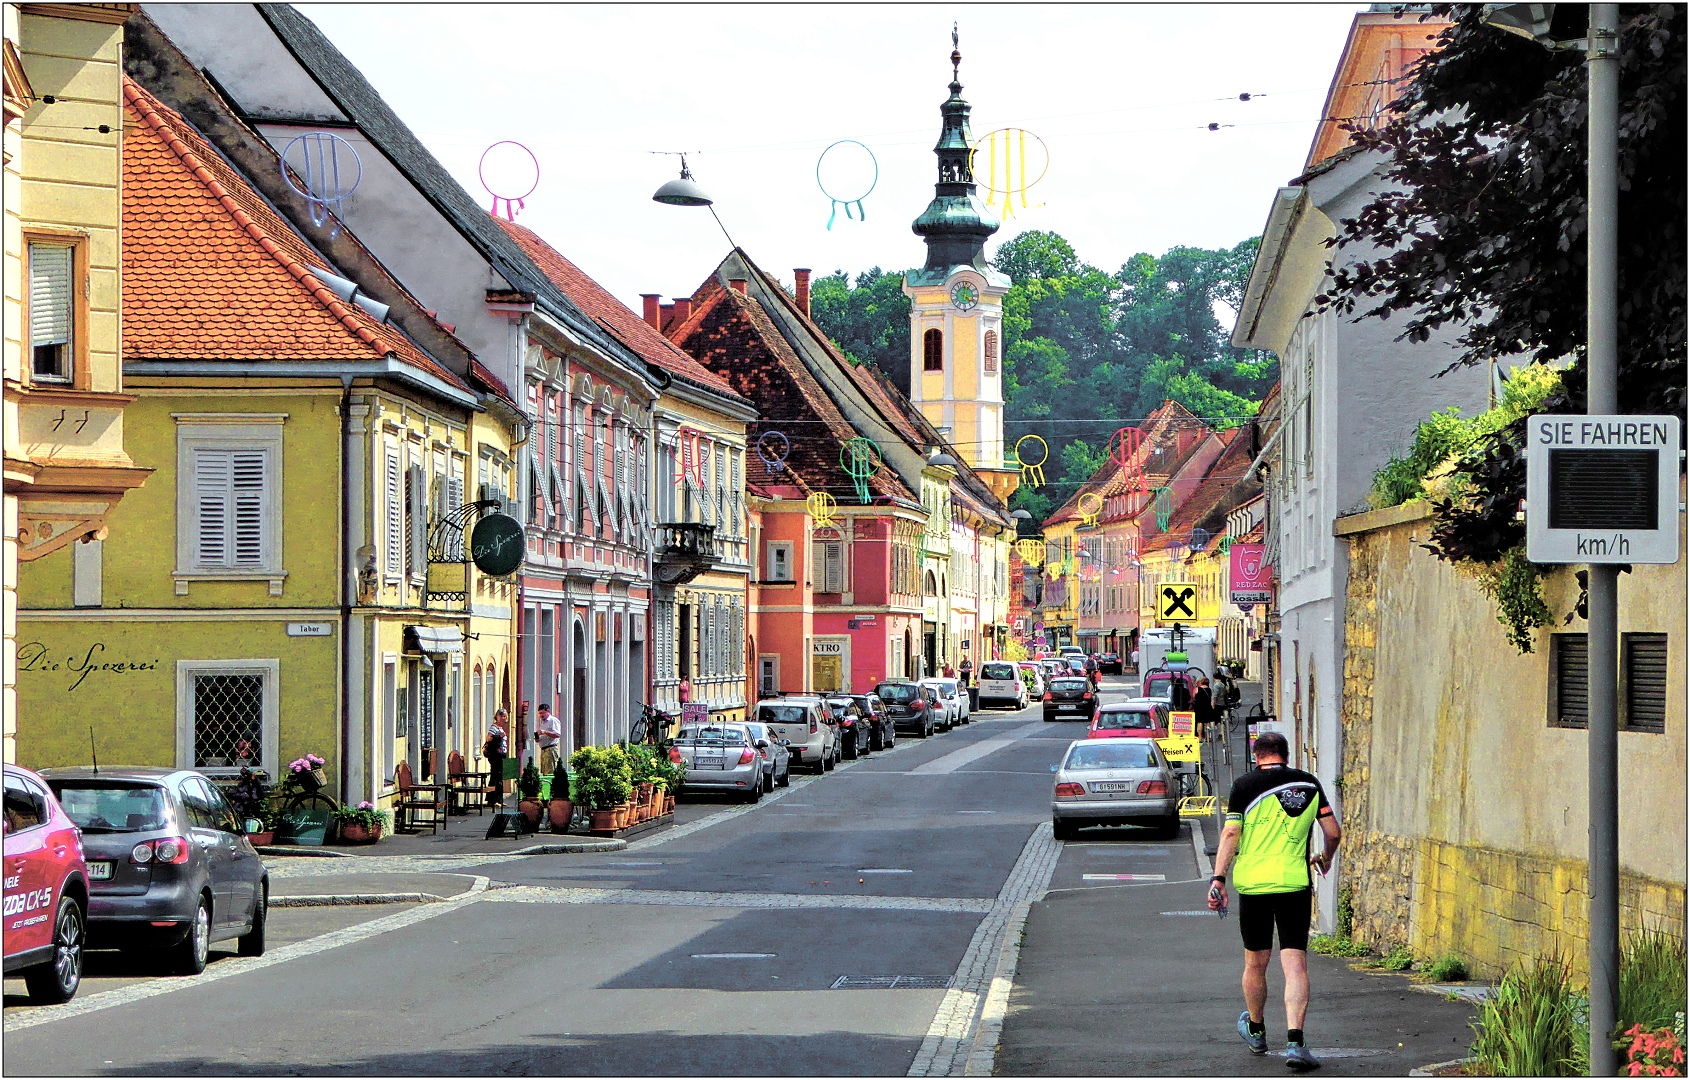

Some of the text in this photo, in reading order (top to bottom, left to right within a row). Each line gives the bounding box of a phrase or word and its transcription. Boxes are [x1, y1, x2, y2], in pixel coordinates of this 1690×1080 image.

[1540, 422, 1668, 445] SIE FAHREN
[1577, 533, 1630, 556] km/h
[1232, 592, 1271, 602] kossär
[17, 641, 158, 692] Die Spezerei
[684, 705, 707, 713] SALE
[1281, 789, 1306, 800] TOUR
[26, 887, 53, 912] CX-5
